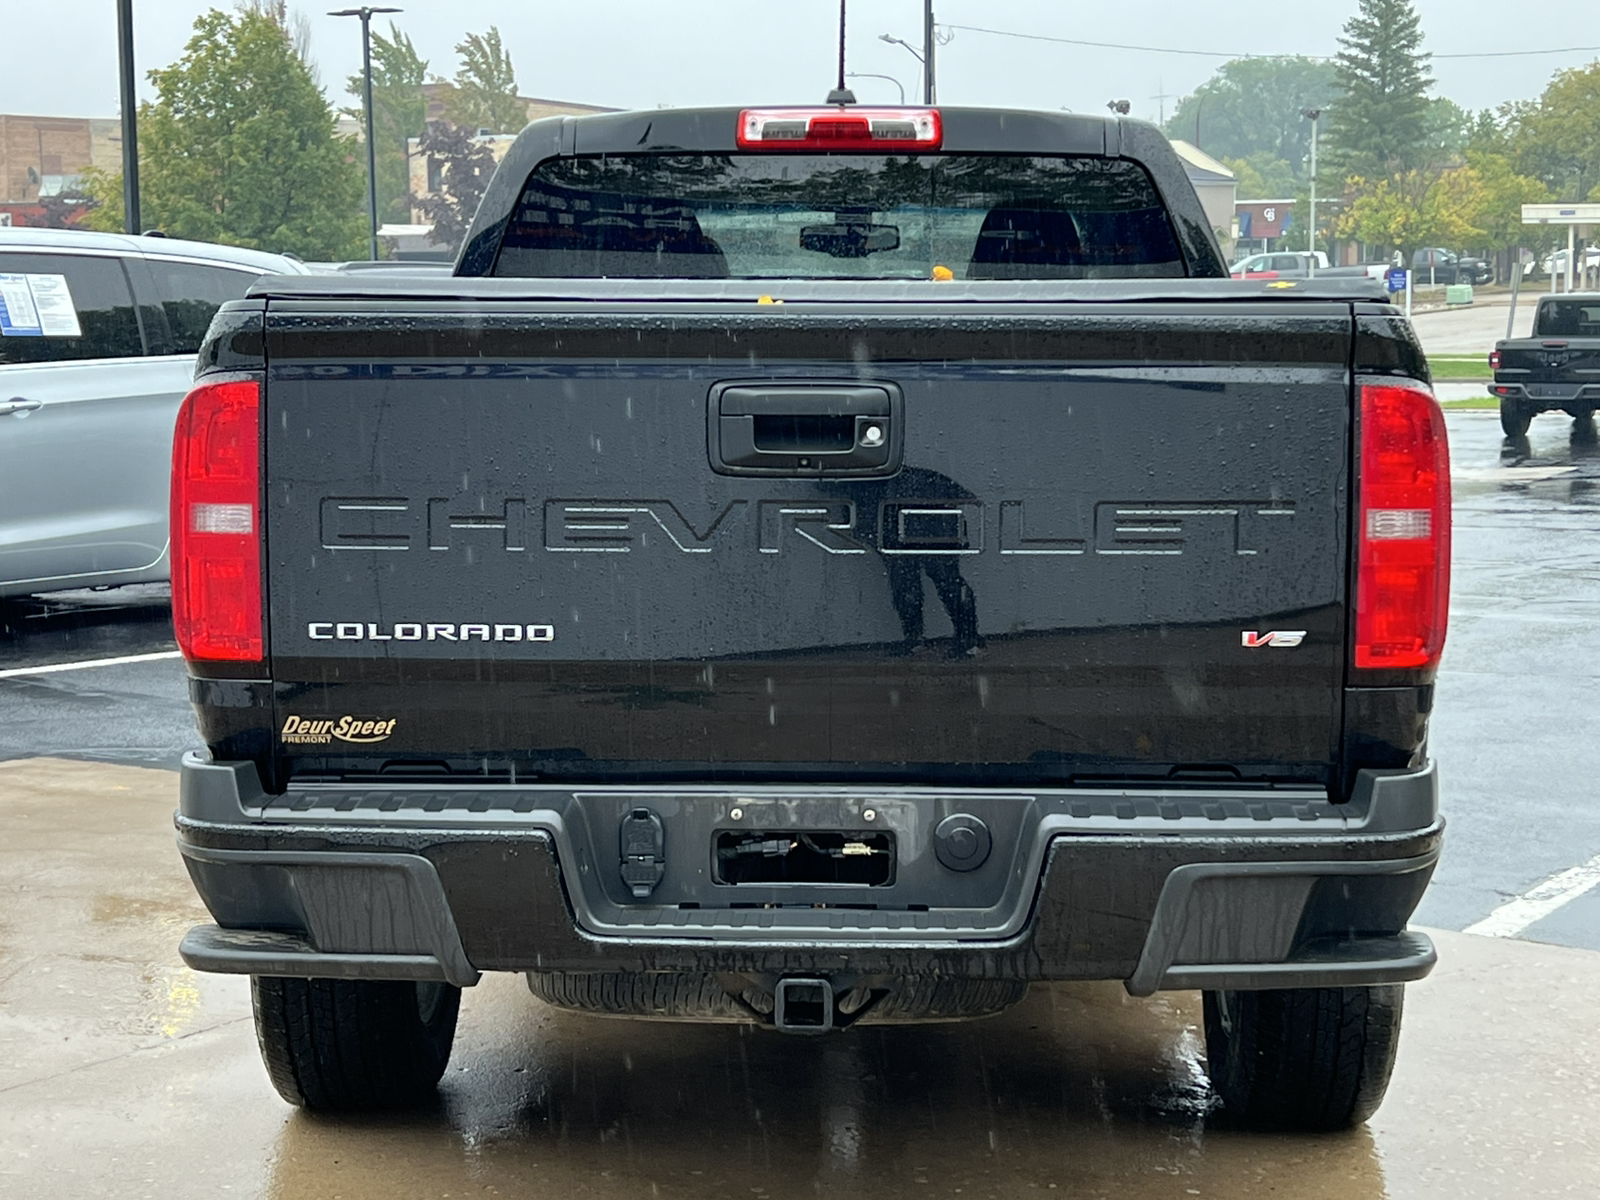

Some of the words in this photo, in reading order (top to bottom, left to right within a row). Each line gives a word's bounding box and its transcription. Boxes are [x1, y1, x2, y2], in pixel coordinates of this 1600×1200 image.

[319, 497, 1297, 555] CHEVROLET
[308, 622, 555, 642] COLORADO
[1241, 630, 1307, 648] V6
[281, 715, 334, 735] Deur
[335, 715, 397, 740] Speet
[281, 735, 332, 744] FREMONT
